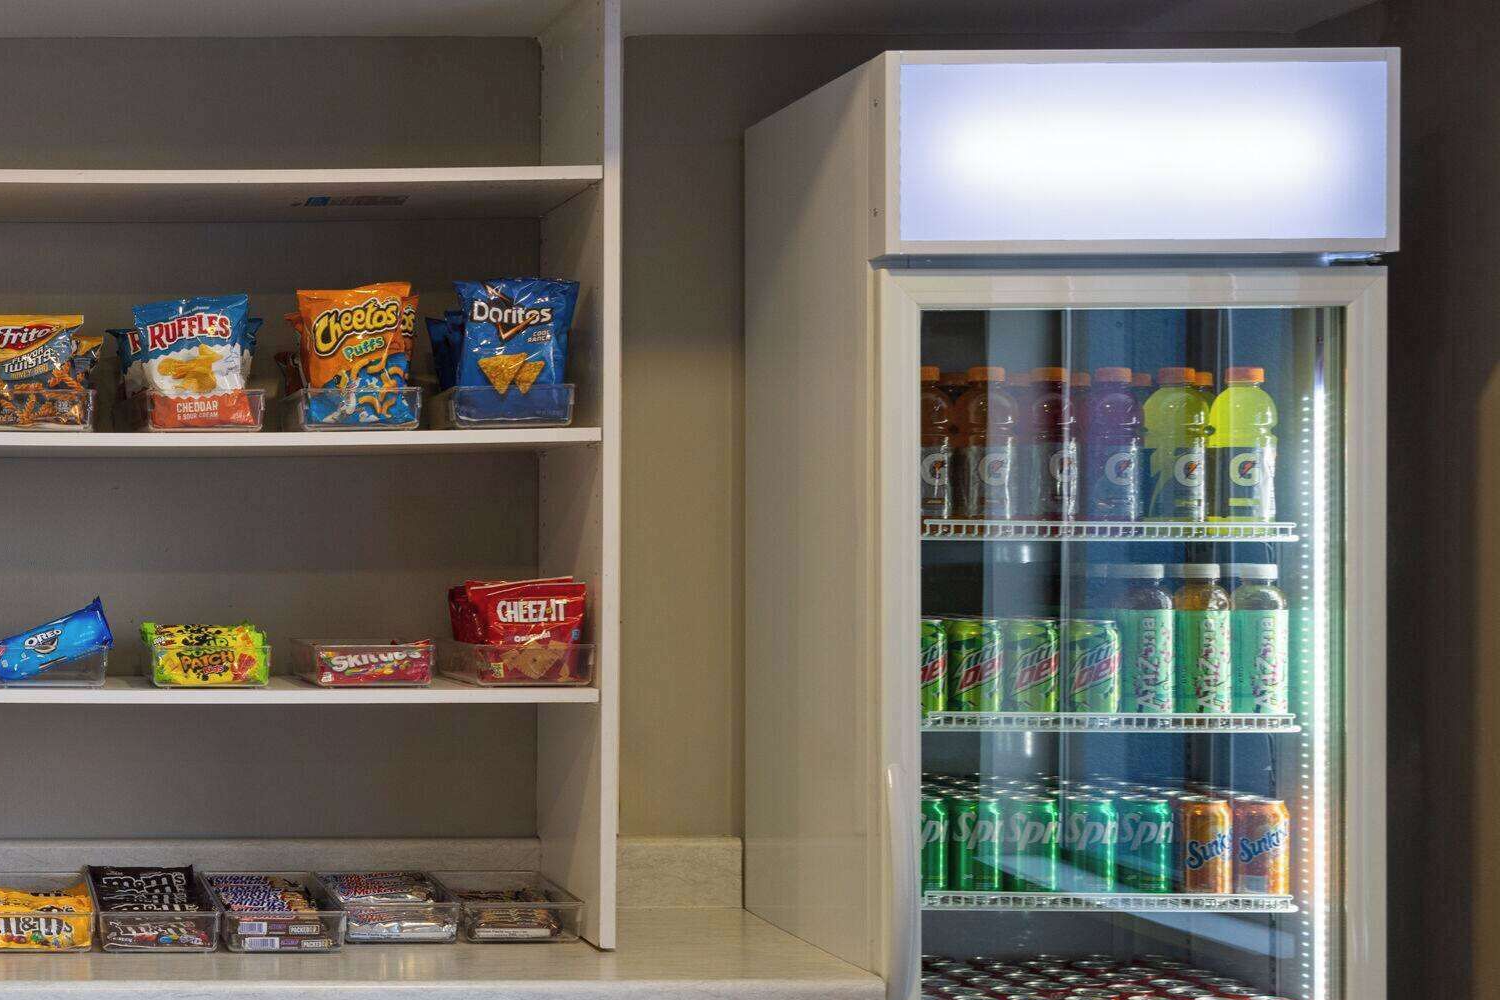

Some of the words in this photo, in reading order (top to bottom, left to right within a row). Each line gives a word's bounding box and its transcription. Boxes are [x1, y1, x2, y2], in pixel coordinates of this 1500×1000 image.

[473, 301, 552, 325] Doritos
[147, 313, 231, 351] RUFFLES
[315, 302, 399, 354] Cheetos
[176, 401, 218, 413] CHEDDAR
[1230, 453, 1267, 487] G
[24, 629, 62, 647] OREO
[181, 650, 235, 674] PATCH
